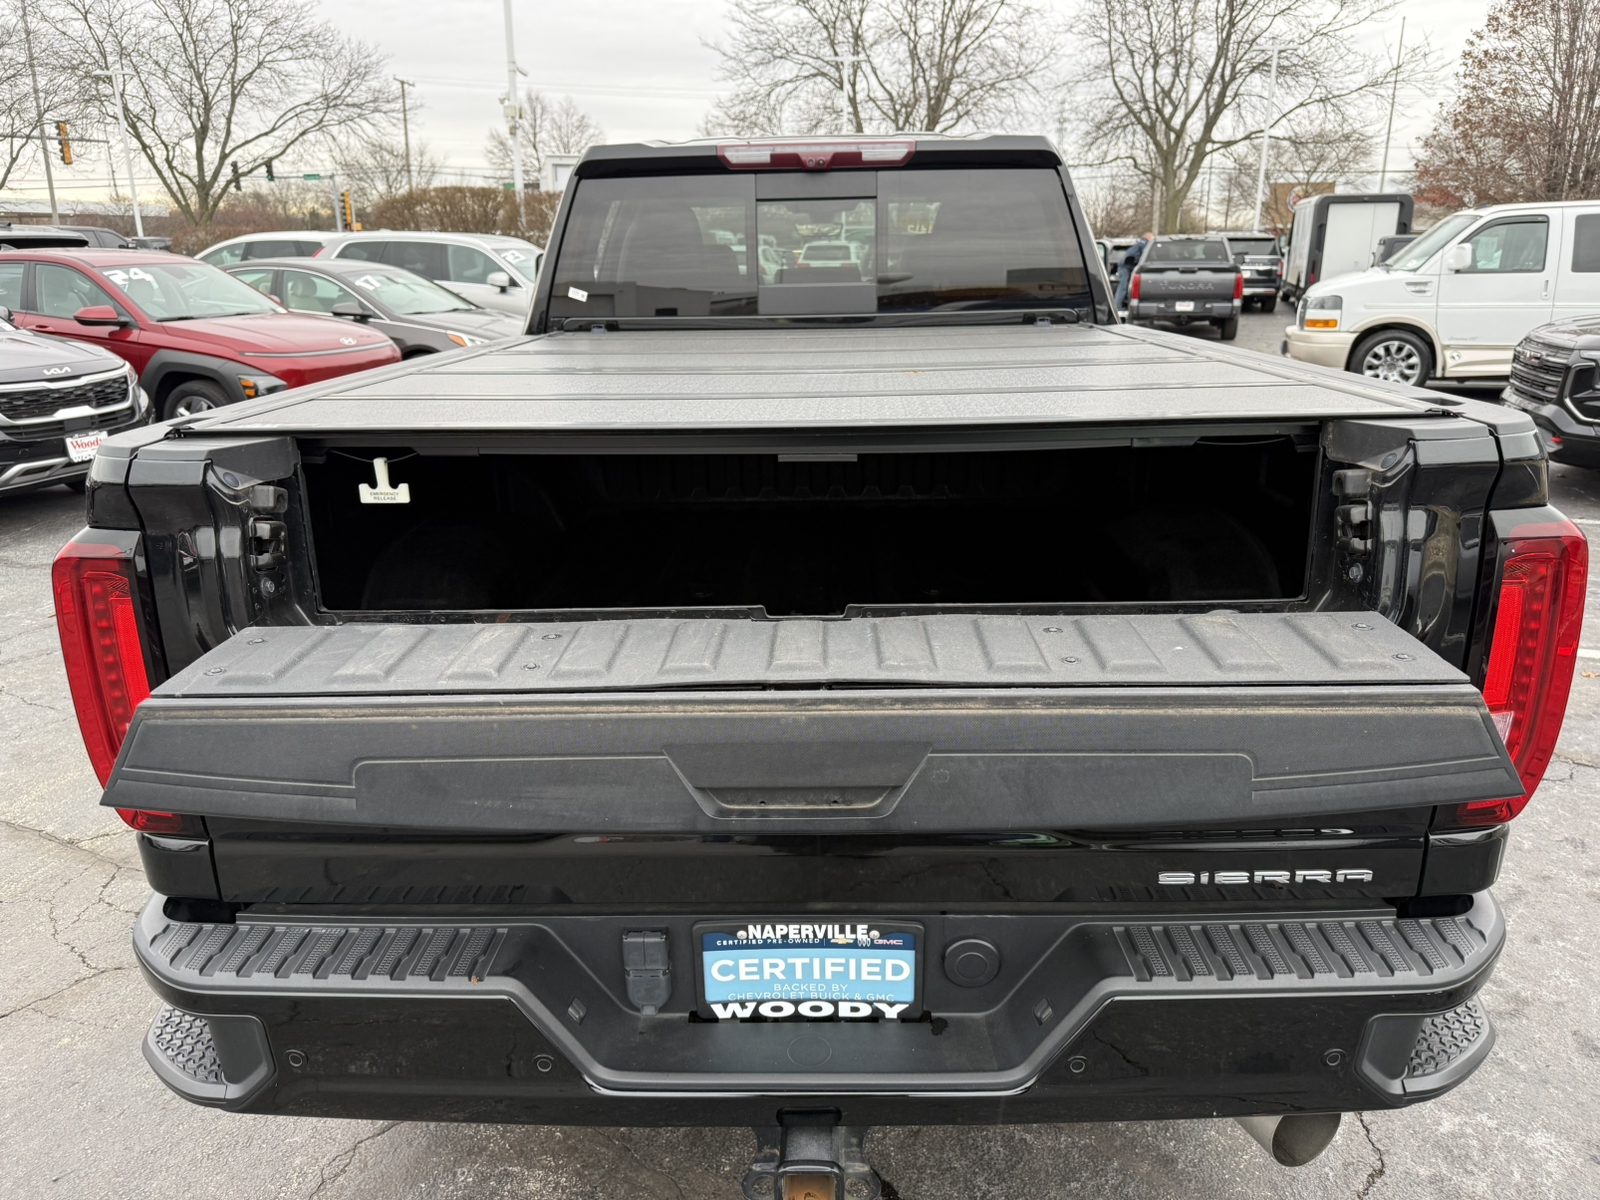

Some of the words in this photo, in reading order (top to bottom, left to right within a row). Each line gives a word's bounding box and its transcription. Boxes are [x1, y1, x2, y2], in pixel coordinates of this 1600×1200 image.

[102, 267, 155, 285] 24
[354, 274, 382, 291] 17
[43, 366, 71, 376] KIA
[1157, 869, 1374, 885] SIERRA
[747, 924, 869, 940] NAPERVILLE
[710, 957, 911, 982] CERTIFIED
[773, 983, 826, 992] BACKED
[831, 983, 849, 992] BY
[728, 991, 805, 1001] CHEVROLET
[810, 992, 850, 1000] BUICK
[854, 992, 862, 1001] &
[866, 993, 895, 1002] GMC
[710, 1001, 910, 1019] WOODY
